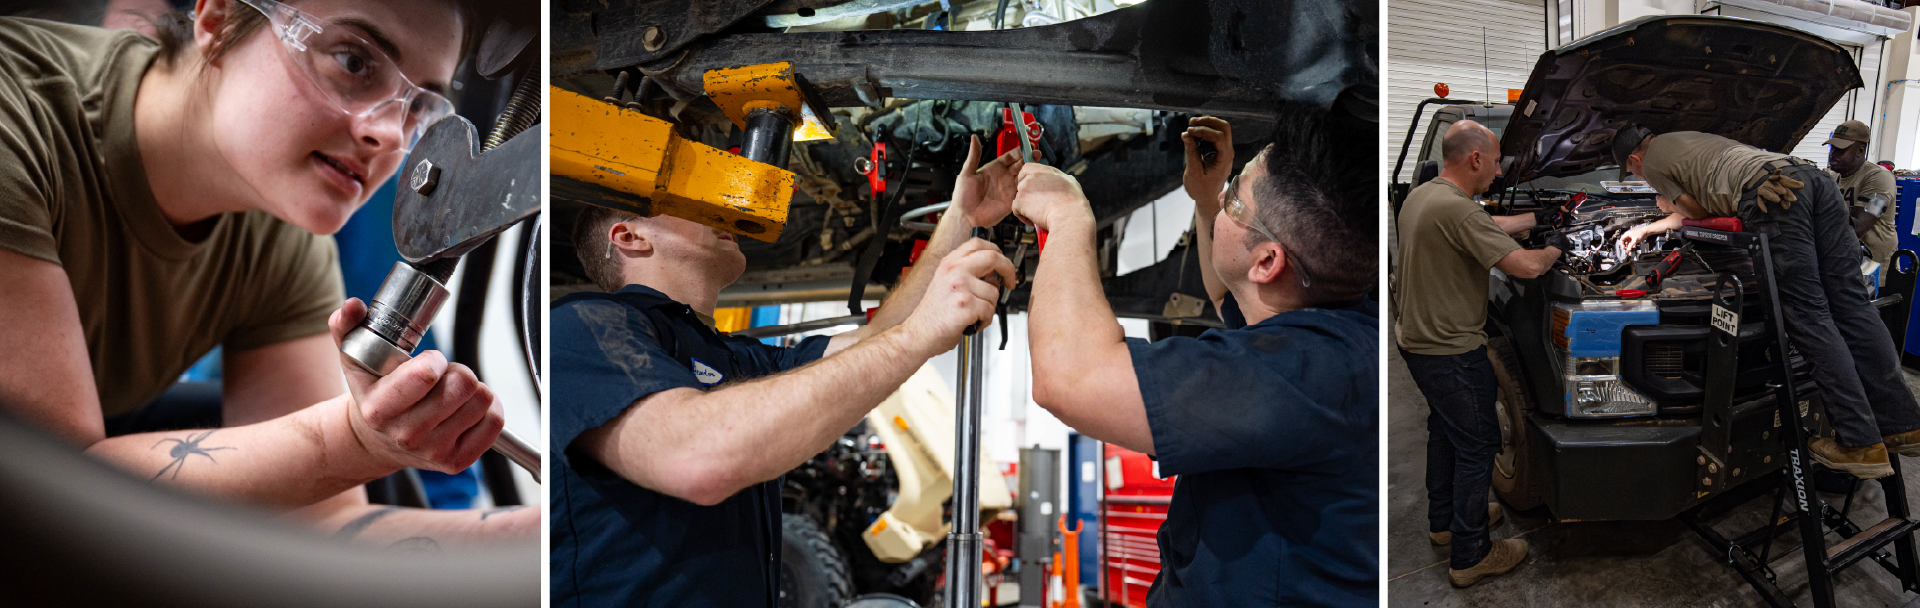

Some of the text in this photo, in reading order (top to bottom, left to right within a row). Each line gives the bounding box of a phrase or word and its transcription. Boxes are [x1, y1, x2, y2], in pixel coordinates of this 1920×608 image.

[1716, 307, 1735, 322] LIFT
[1712, 316, 1736, 333] POINT
[1790, 448, 1809, 512] TRAXION
